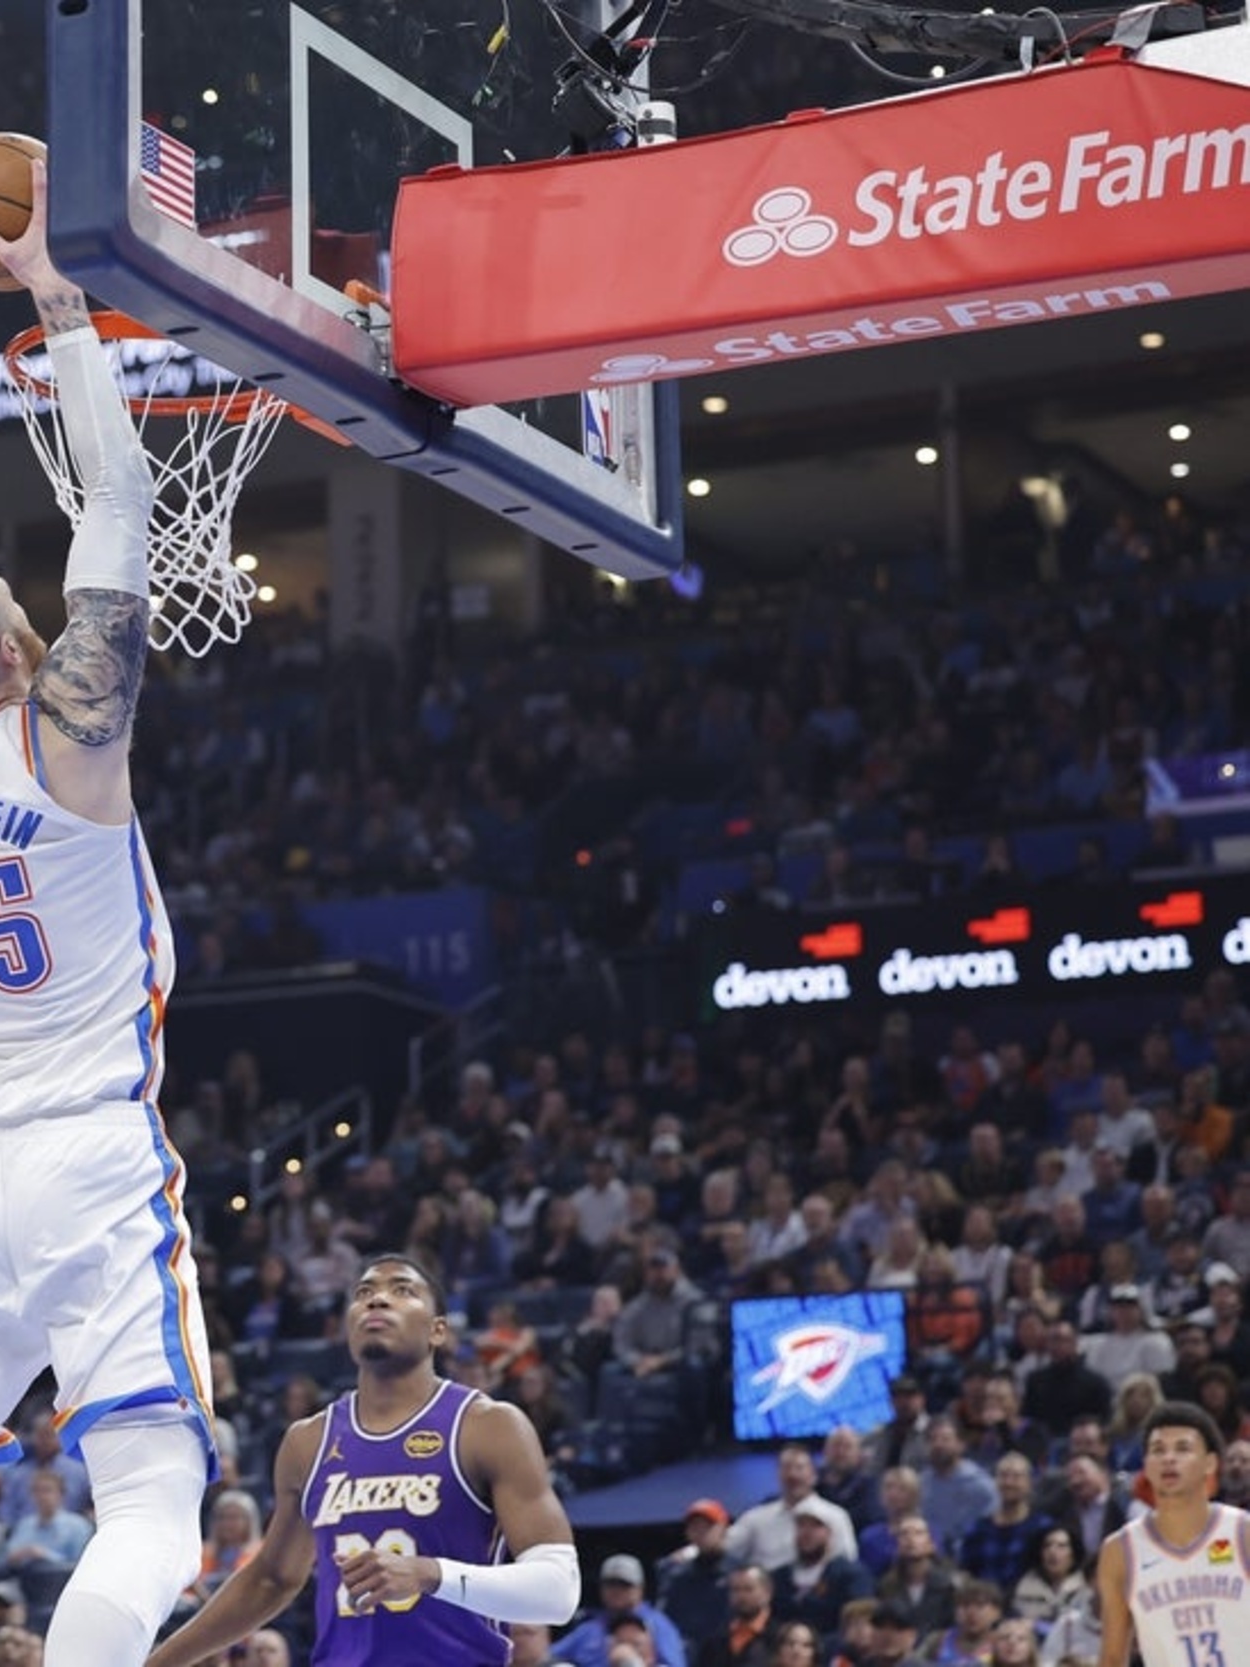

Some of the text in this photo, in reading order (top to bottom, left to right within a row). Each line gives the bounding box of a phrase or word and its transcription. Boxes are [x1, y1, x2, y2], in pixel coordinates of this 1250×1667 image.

[406, 929, 470, 976] 115
[879, 948, 1018, 994] devon
[1048, 933, 1192, 979] devon
[713, 962, 850, 1008] devon
[312, 1472, 442, 1529] LAKERS
[1137, 1574, 1244, 1613] OKLAHOMA
[1171, 1602, 1216, 1631] CITY
